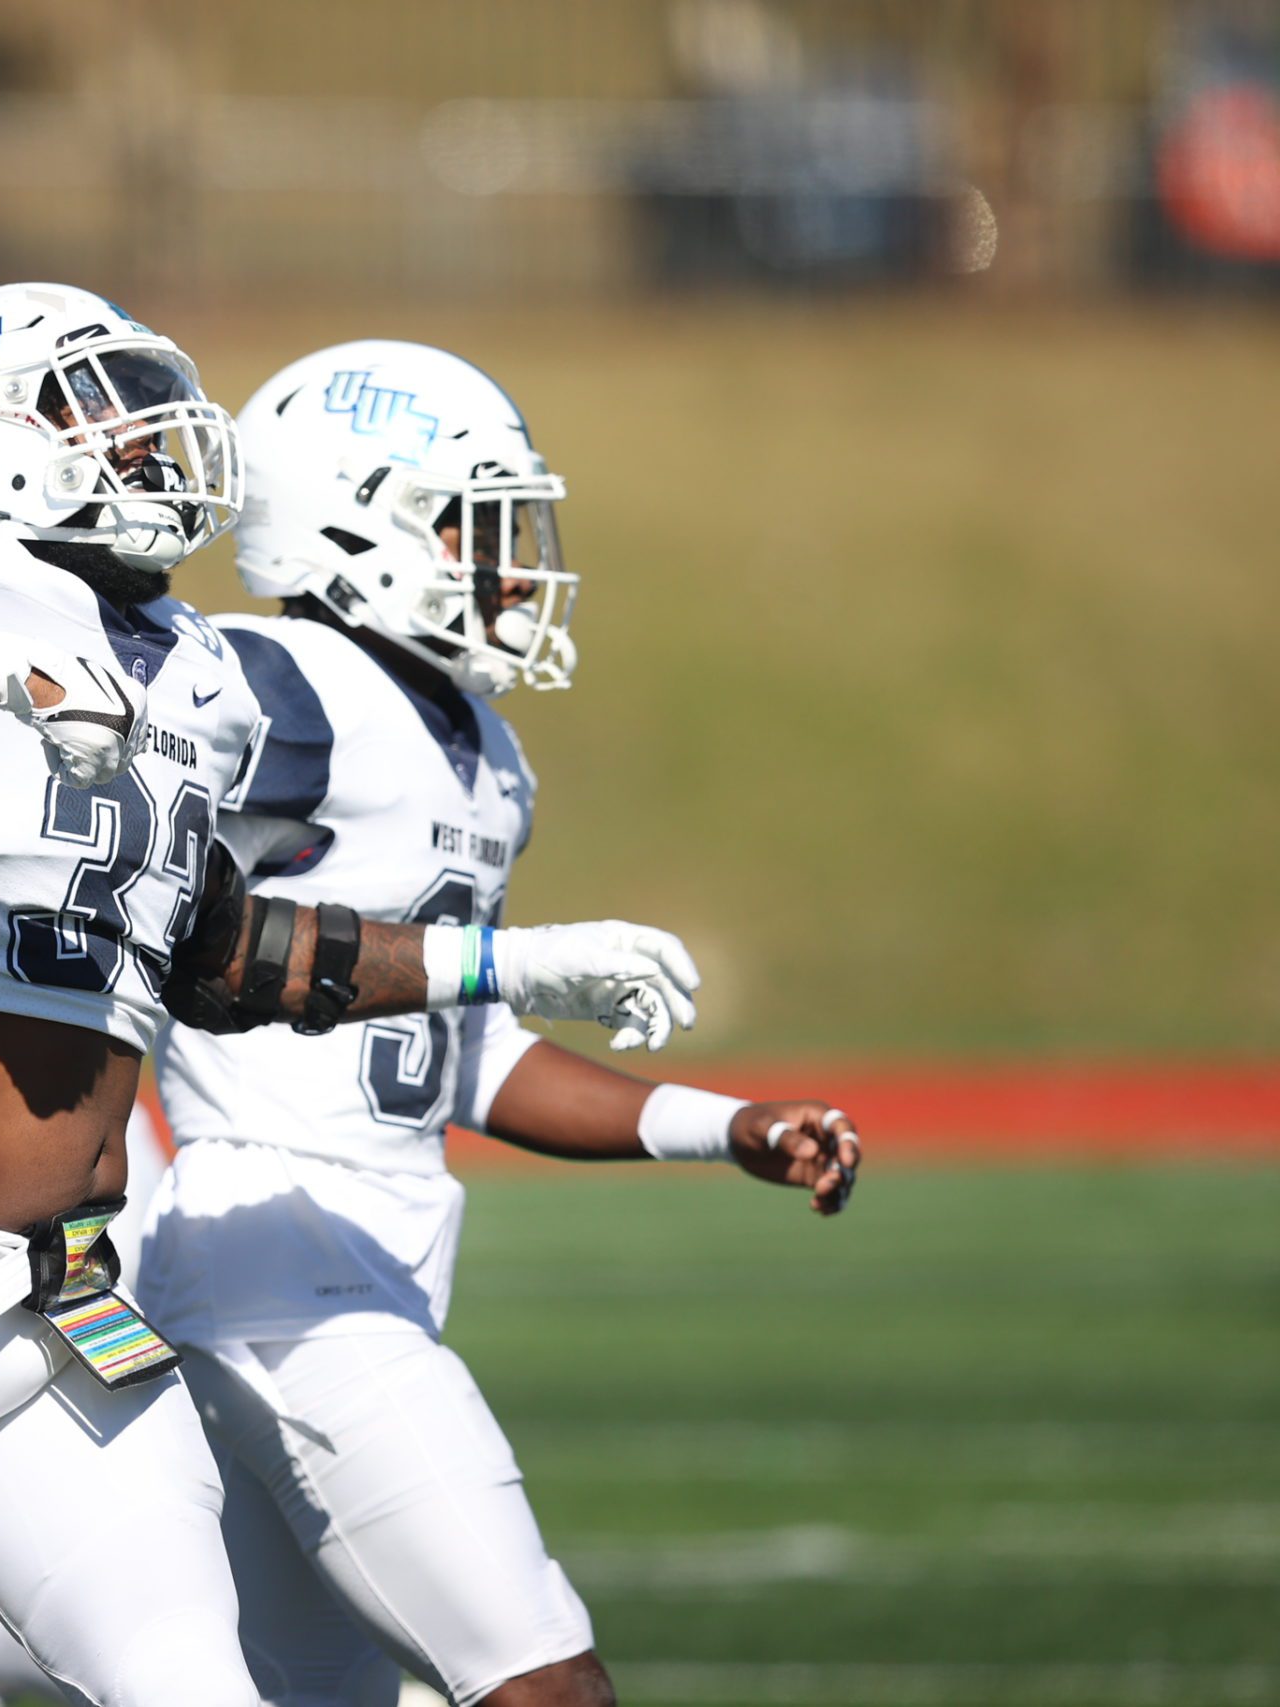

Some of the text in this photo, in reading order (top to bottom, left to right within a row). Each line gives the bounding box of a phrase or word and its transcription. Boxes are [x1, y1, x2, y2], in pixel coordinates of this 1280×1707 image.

[324, 371, 439, 466] UWF
[147, 723, 197, 770] FLORIDA
[431, 821, 463, 856] WEST
[7, 762, 218, 1003] 33
